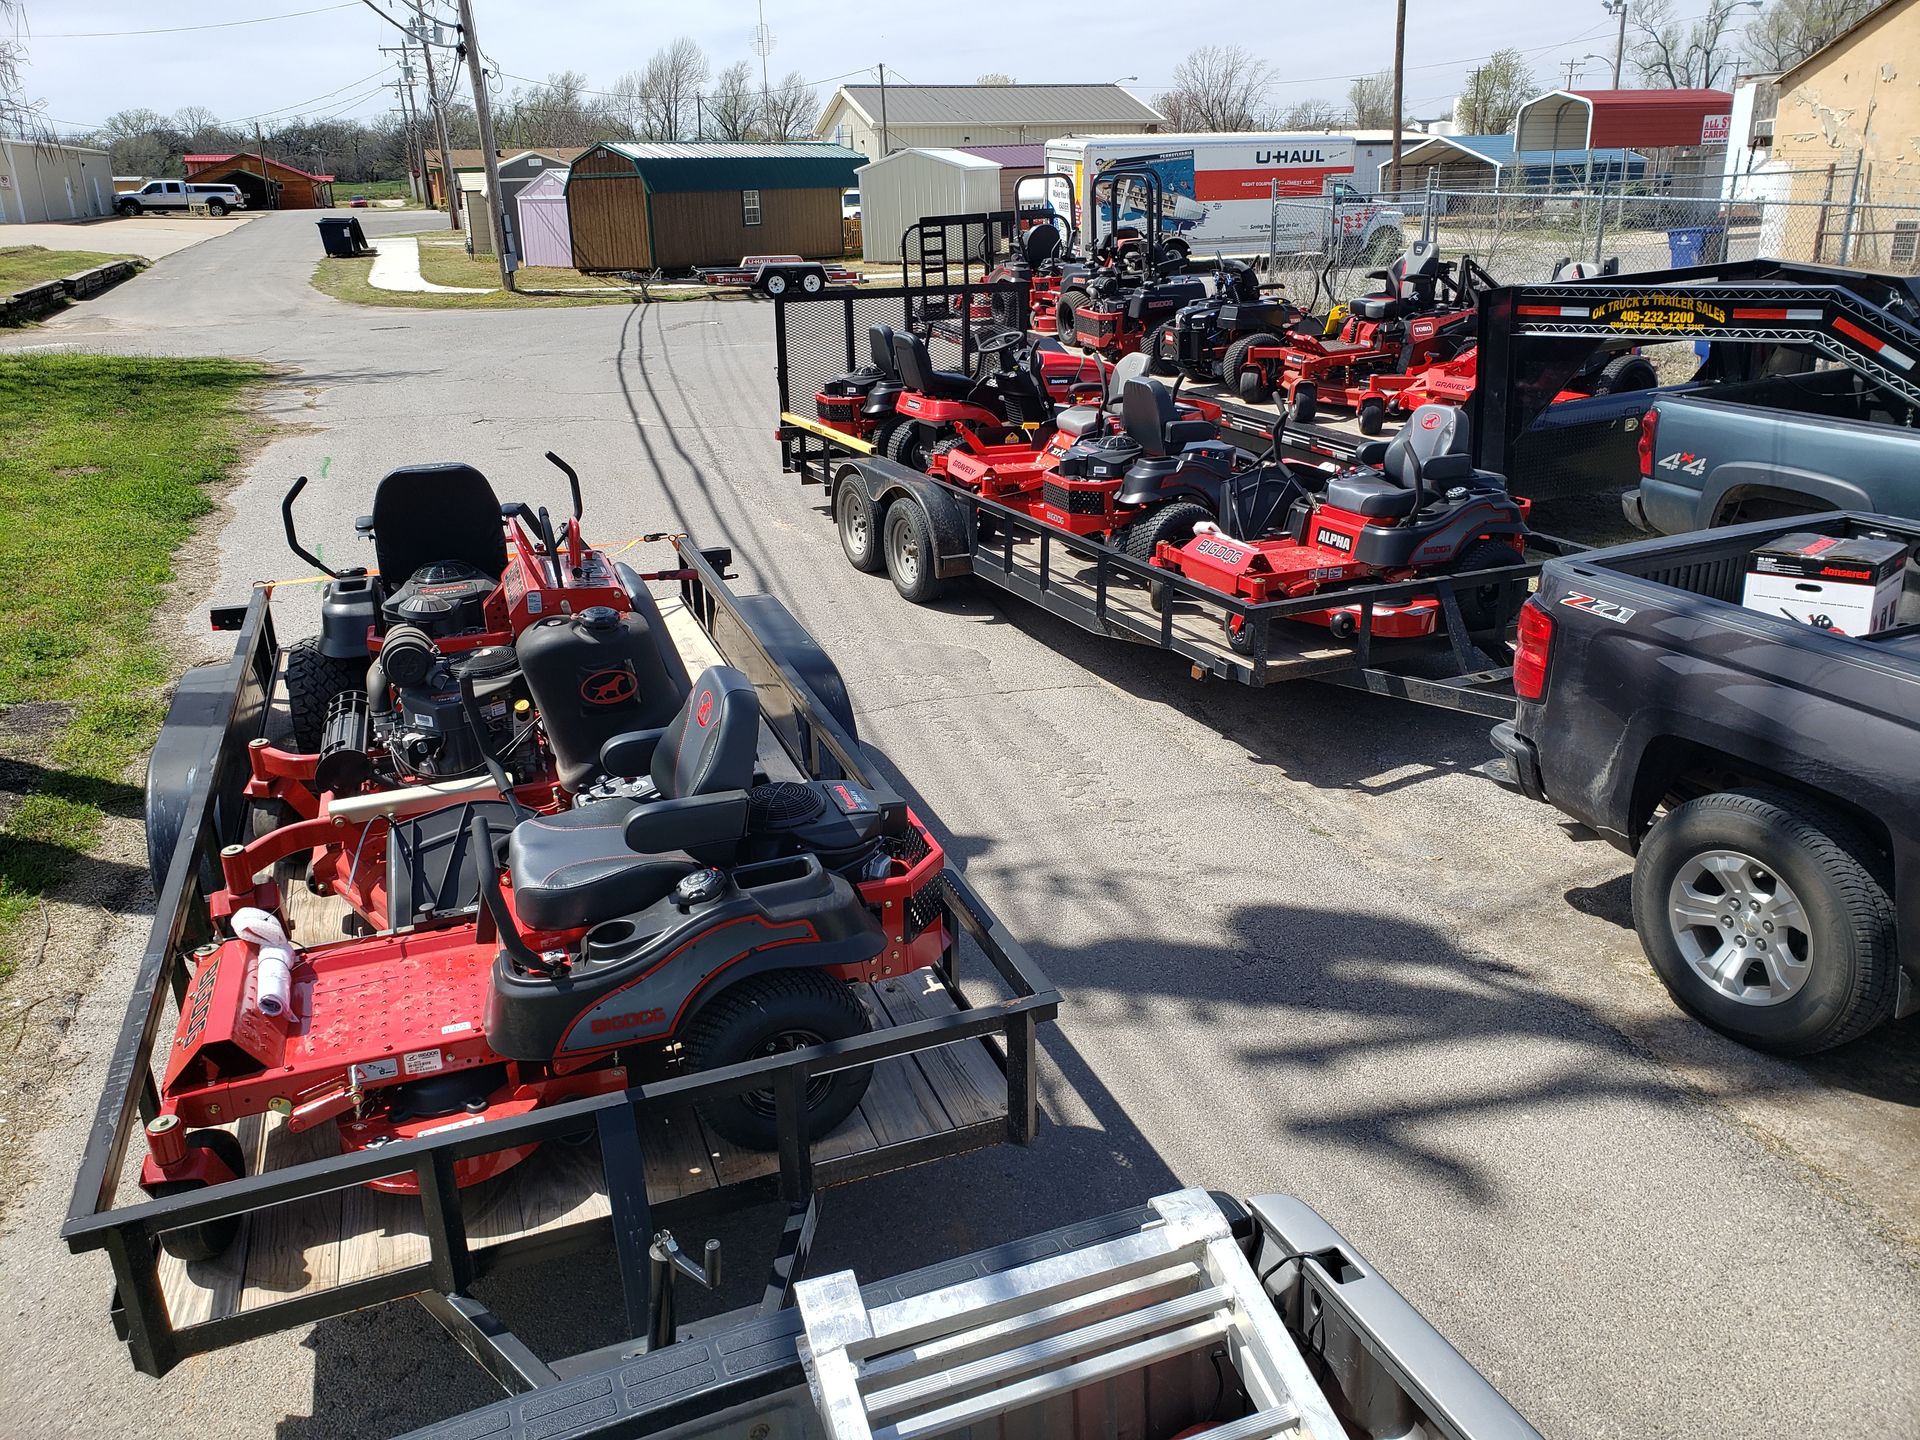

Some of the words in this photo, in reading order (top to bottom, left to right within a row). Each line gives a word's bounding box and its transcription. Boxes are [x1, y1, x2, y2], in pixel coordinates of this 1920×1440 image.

[1256, 150, 1325, 164] U-HAUL
[1592, 304, 1606, 320] OK
[1608, 296, 1640, 313] TRUCK
[1642, 295, 1650, 306] &
[1653, 295, 1694, 311] TRAILER
[1696, 300, 1726, 324] SALES
[1620, 310, 1695, 323] 405-232-1200
[1415, 325, 1432, 333] TORO
[1434, 380, 1471, 390] GRAVELY
[952, 459, 976, 476] GRAVELY
[1318, 529, 1351, 551] ALPHA
[1197, 539, 1244, 565] BIGDOG
[1820, 566, 1872, 579] Jonsered
[1560, 590, 1637, 624] Z71
[184, 957, 220, 1050] BIGDOG
[591, 1007, 667, 1034] BIGDOG
